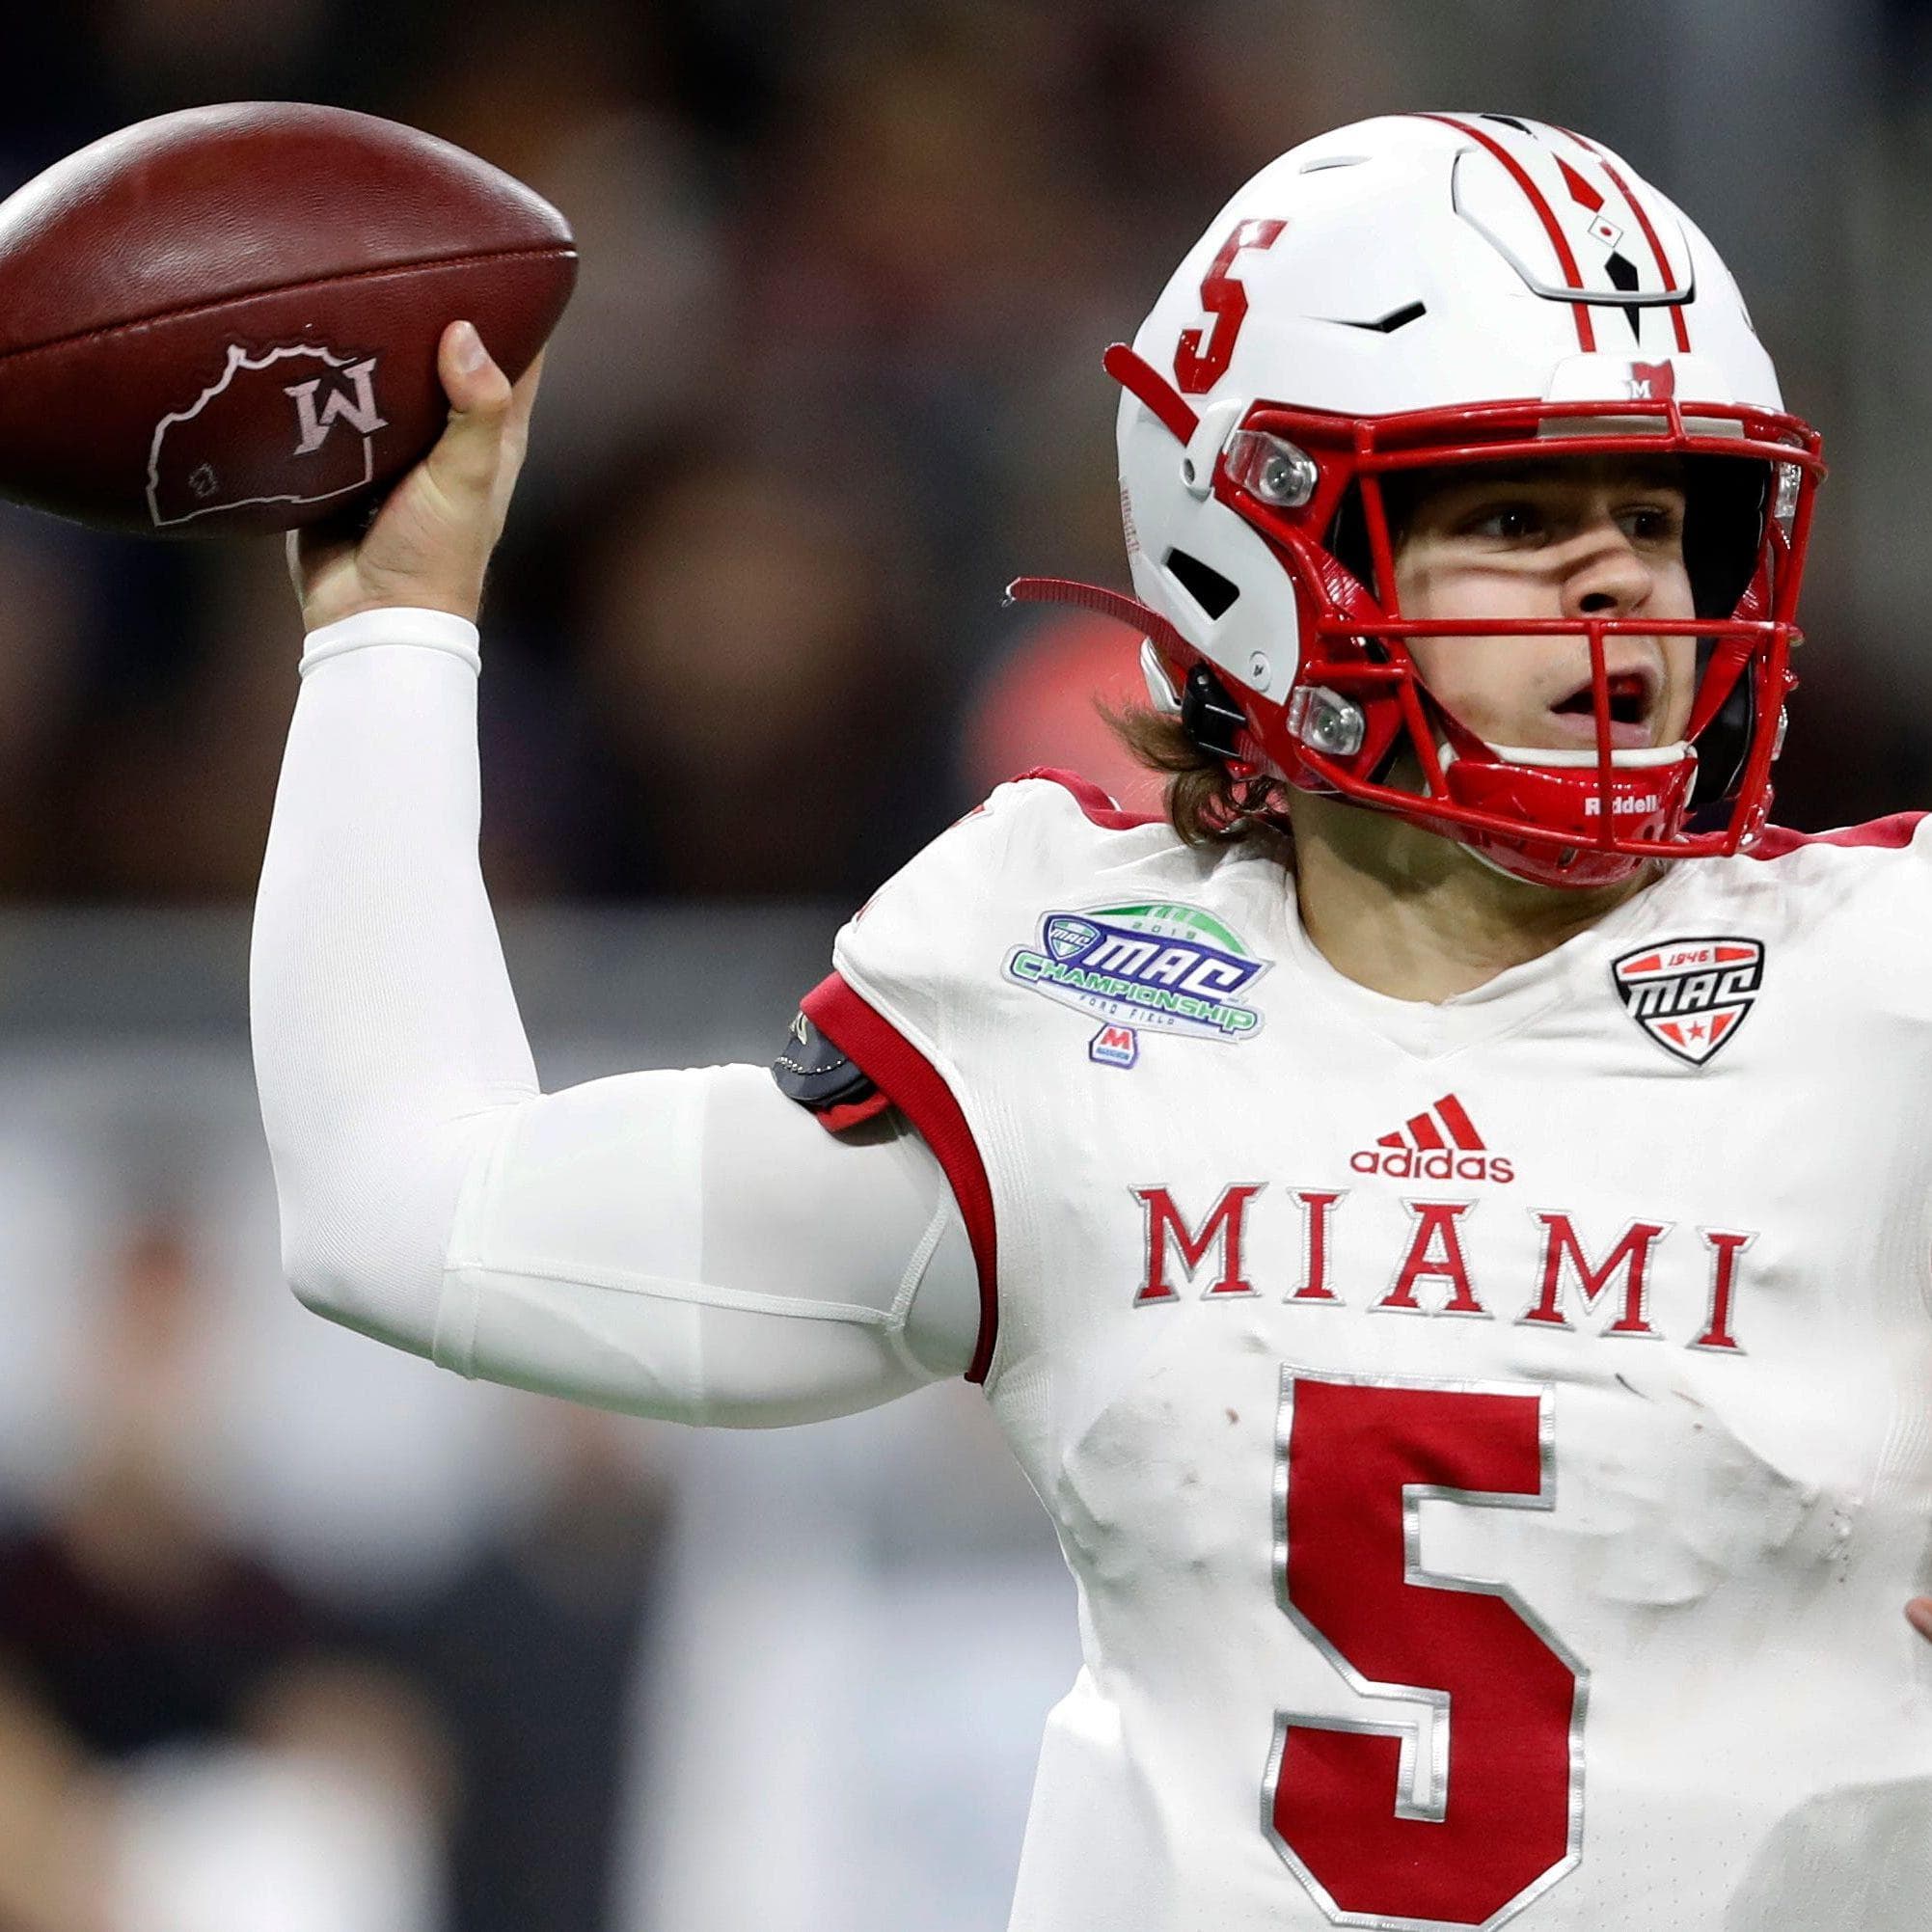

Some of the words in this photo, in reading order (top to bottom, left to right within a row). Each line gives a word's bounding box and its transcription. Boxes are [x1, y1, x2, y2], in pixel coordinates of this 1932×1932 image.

[1173, 218, 1289, 395] 5
[284, 358, 389, 455] M
[1585, 795, 1659, 816] Rddell
[1082, 935, 1244, 996] MAC
[1669, 949, 1709, 966] 1946
[1012, 950, 1257, 1032] CHAMPIONSHIP
[1626, 966, 1759, 1017] MAC
[1100, 1027, 1130, 1050] M
[1350, 1148, 1515, 1184] adidas
[1128, 1182, 1760, 1355] MIAMI
[1261, 1362, 1592, 1932] 5
